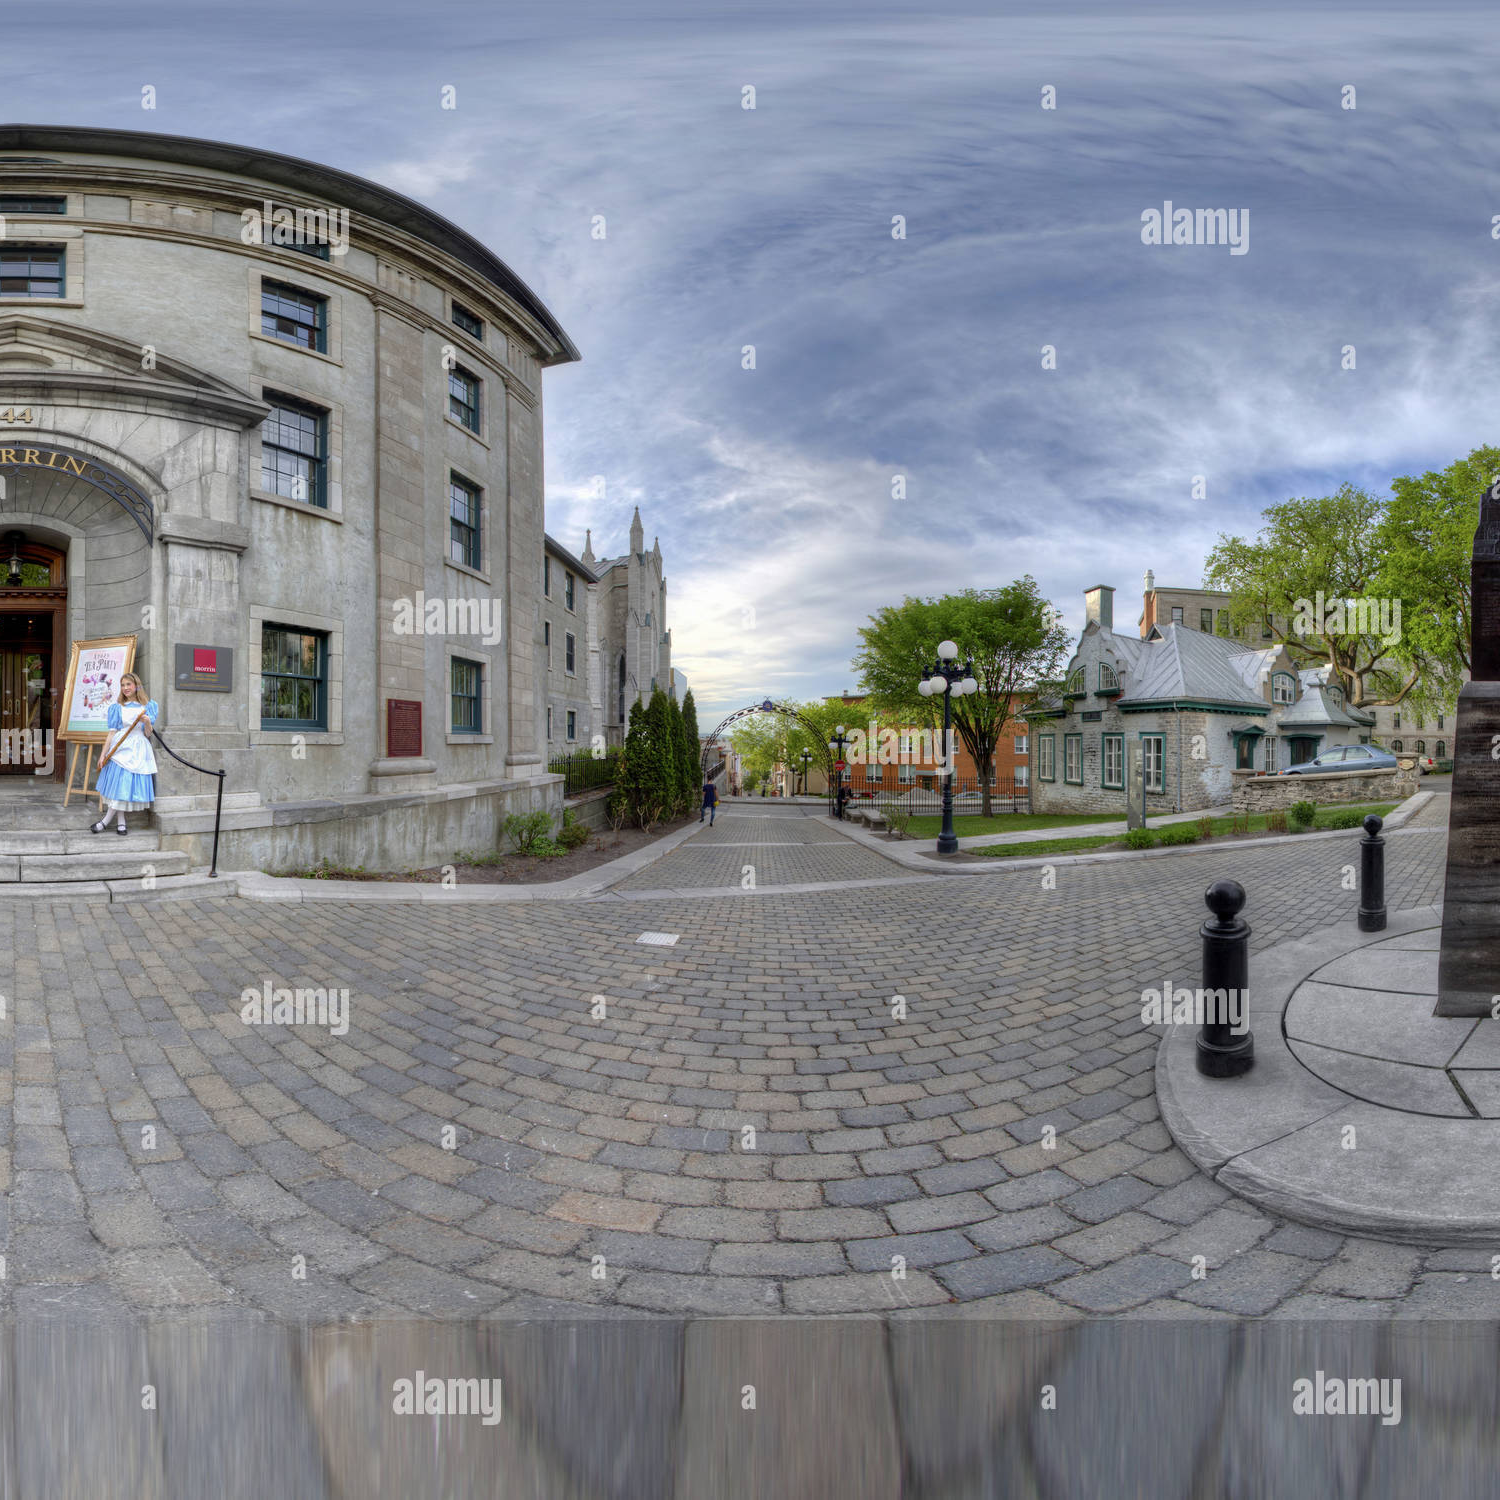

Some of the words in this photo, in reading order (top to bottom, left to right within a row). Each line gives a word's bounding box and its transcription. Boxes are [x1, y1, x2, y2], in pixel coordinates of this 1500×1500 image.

[0, 407, 33, 424] 44
[96, 658, 117, 672] PARTY
[194, 664, 216, 672] morrin
